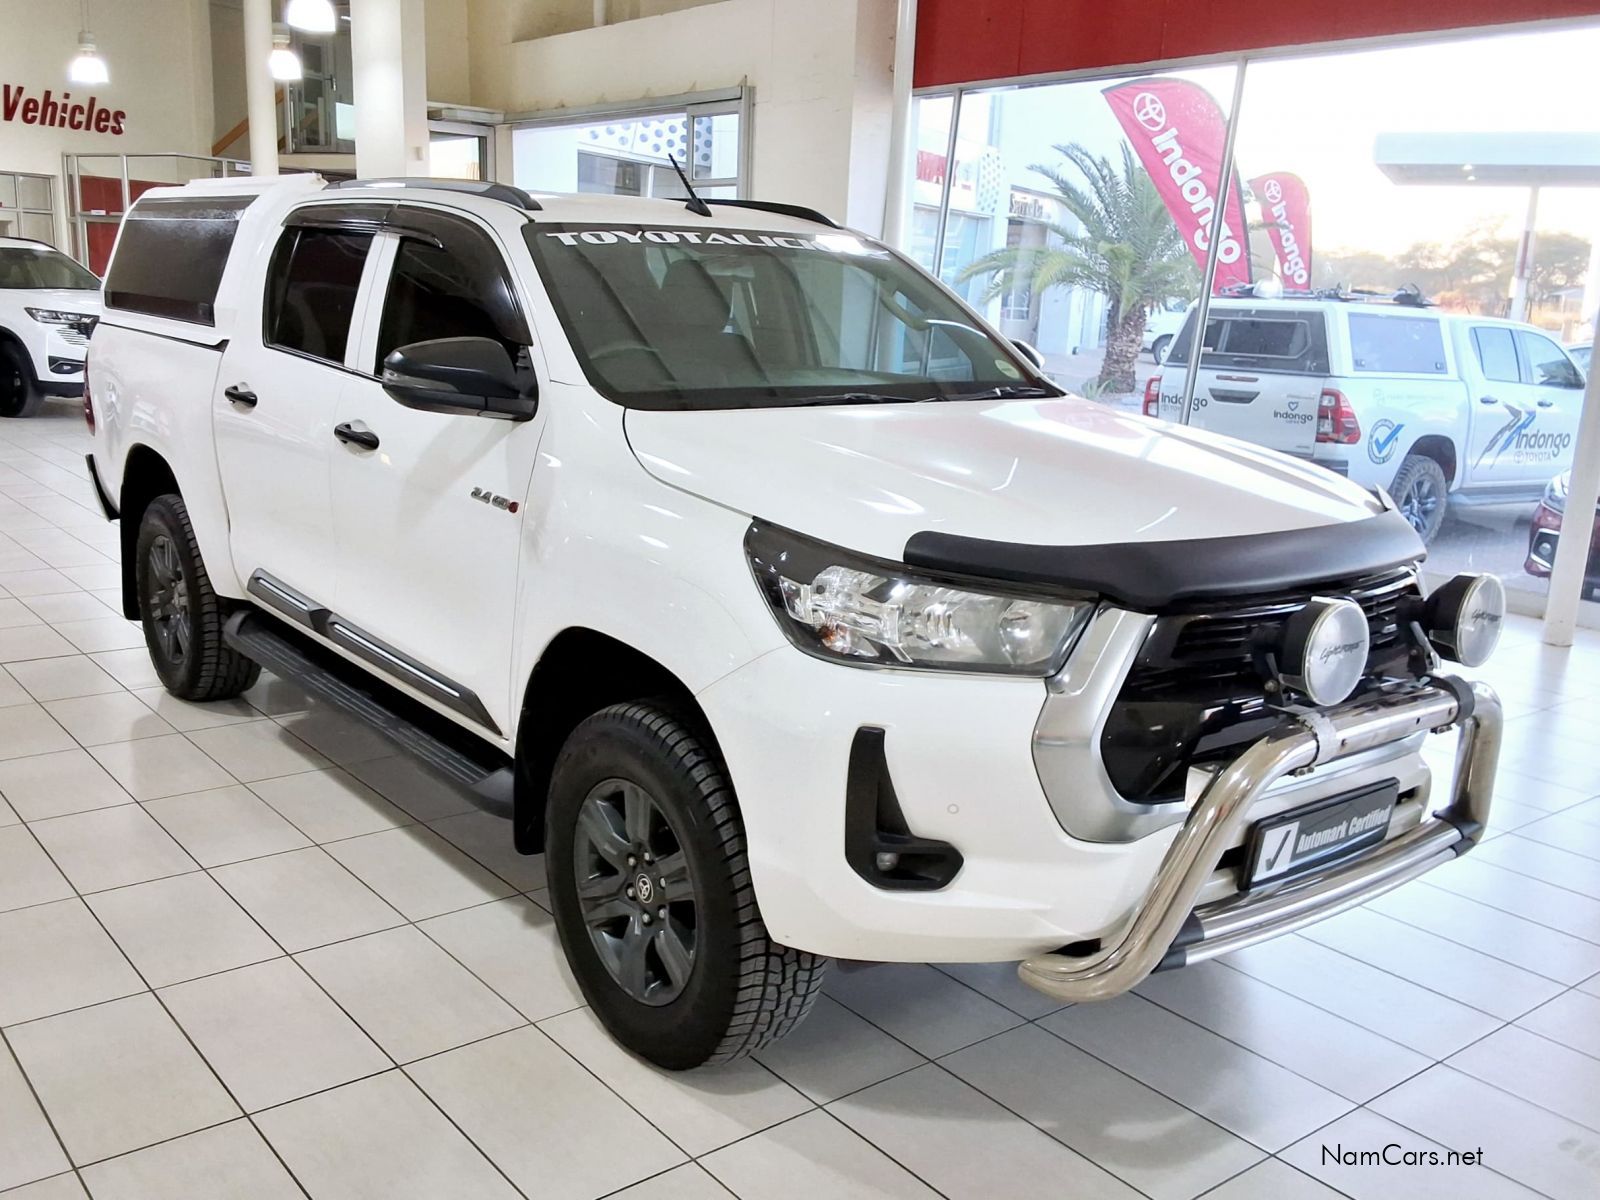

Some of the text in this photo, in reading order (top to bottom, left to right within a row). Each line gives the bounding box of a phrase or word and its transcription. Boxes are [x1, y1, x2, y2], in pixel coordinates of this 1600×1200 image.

[3, 84, 126, 135] Vehicles
[1161, 392, 1208, 412] Indogo
[1273, 410, 1313, 425] Indongo
[1515, 429, 1571, 457] Indongo
[1524, 451, 1551, 462] TOYOTA
[1296, 804, 1392, 854] Automark Certified
